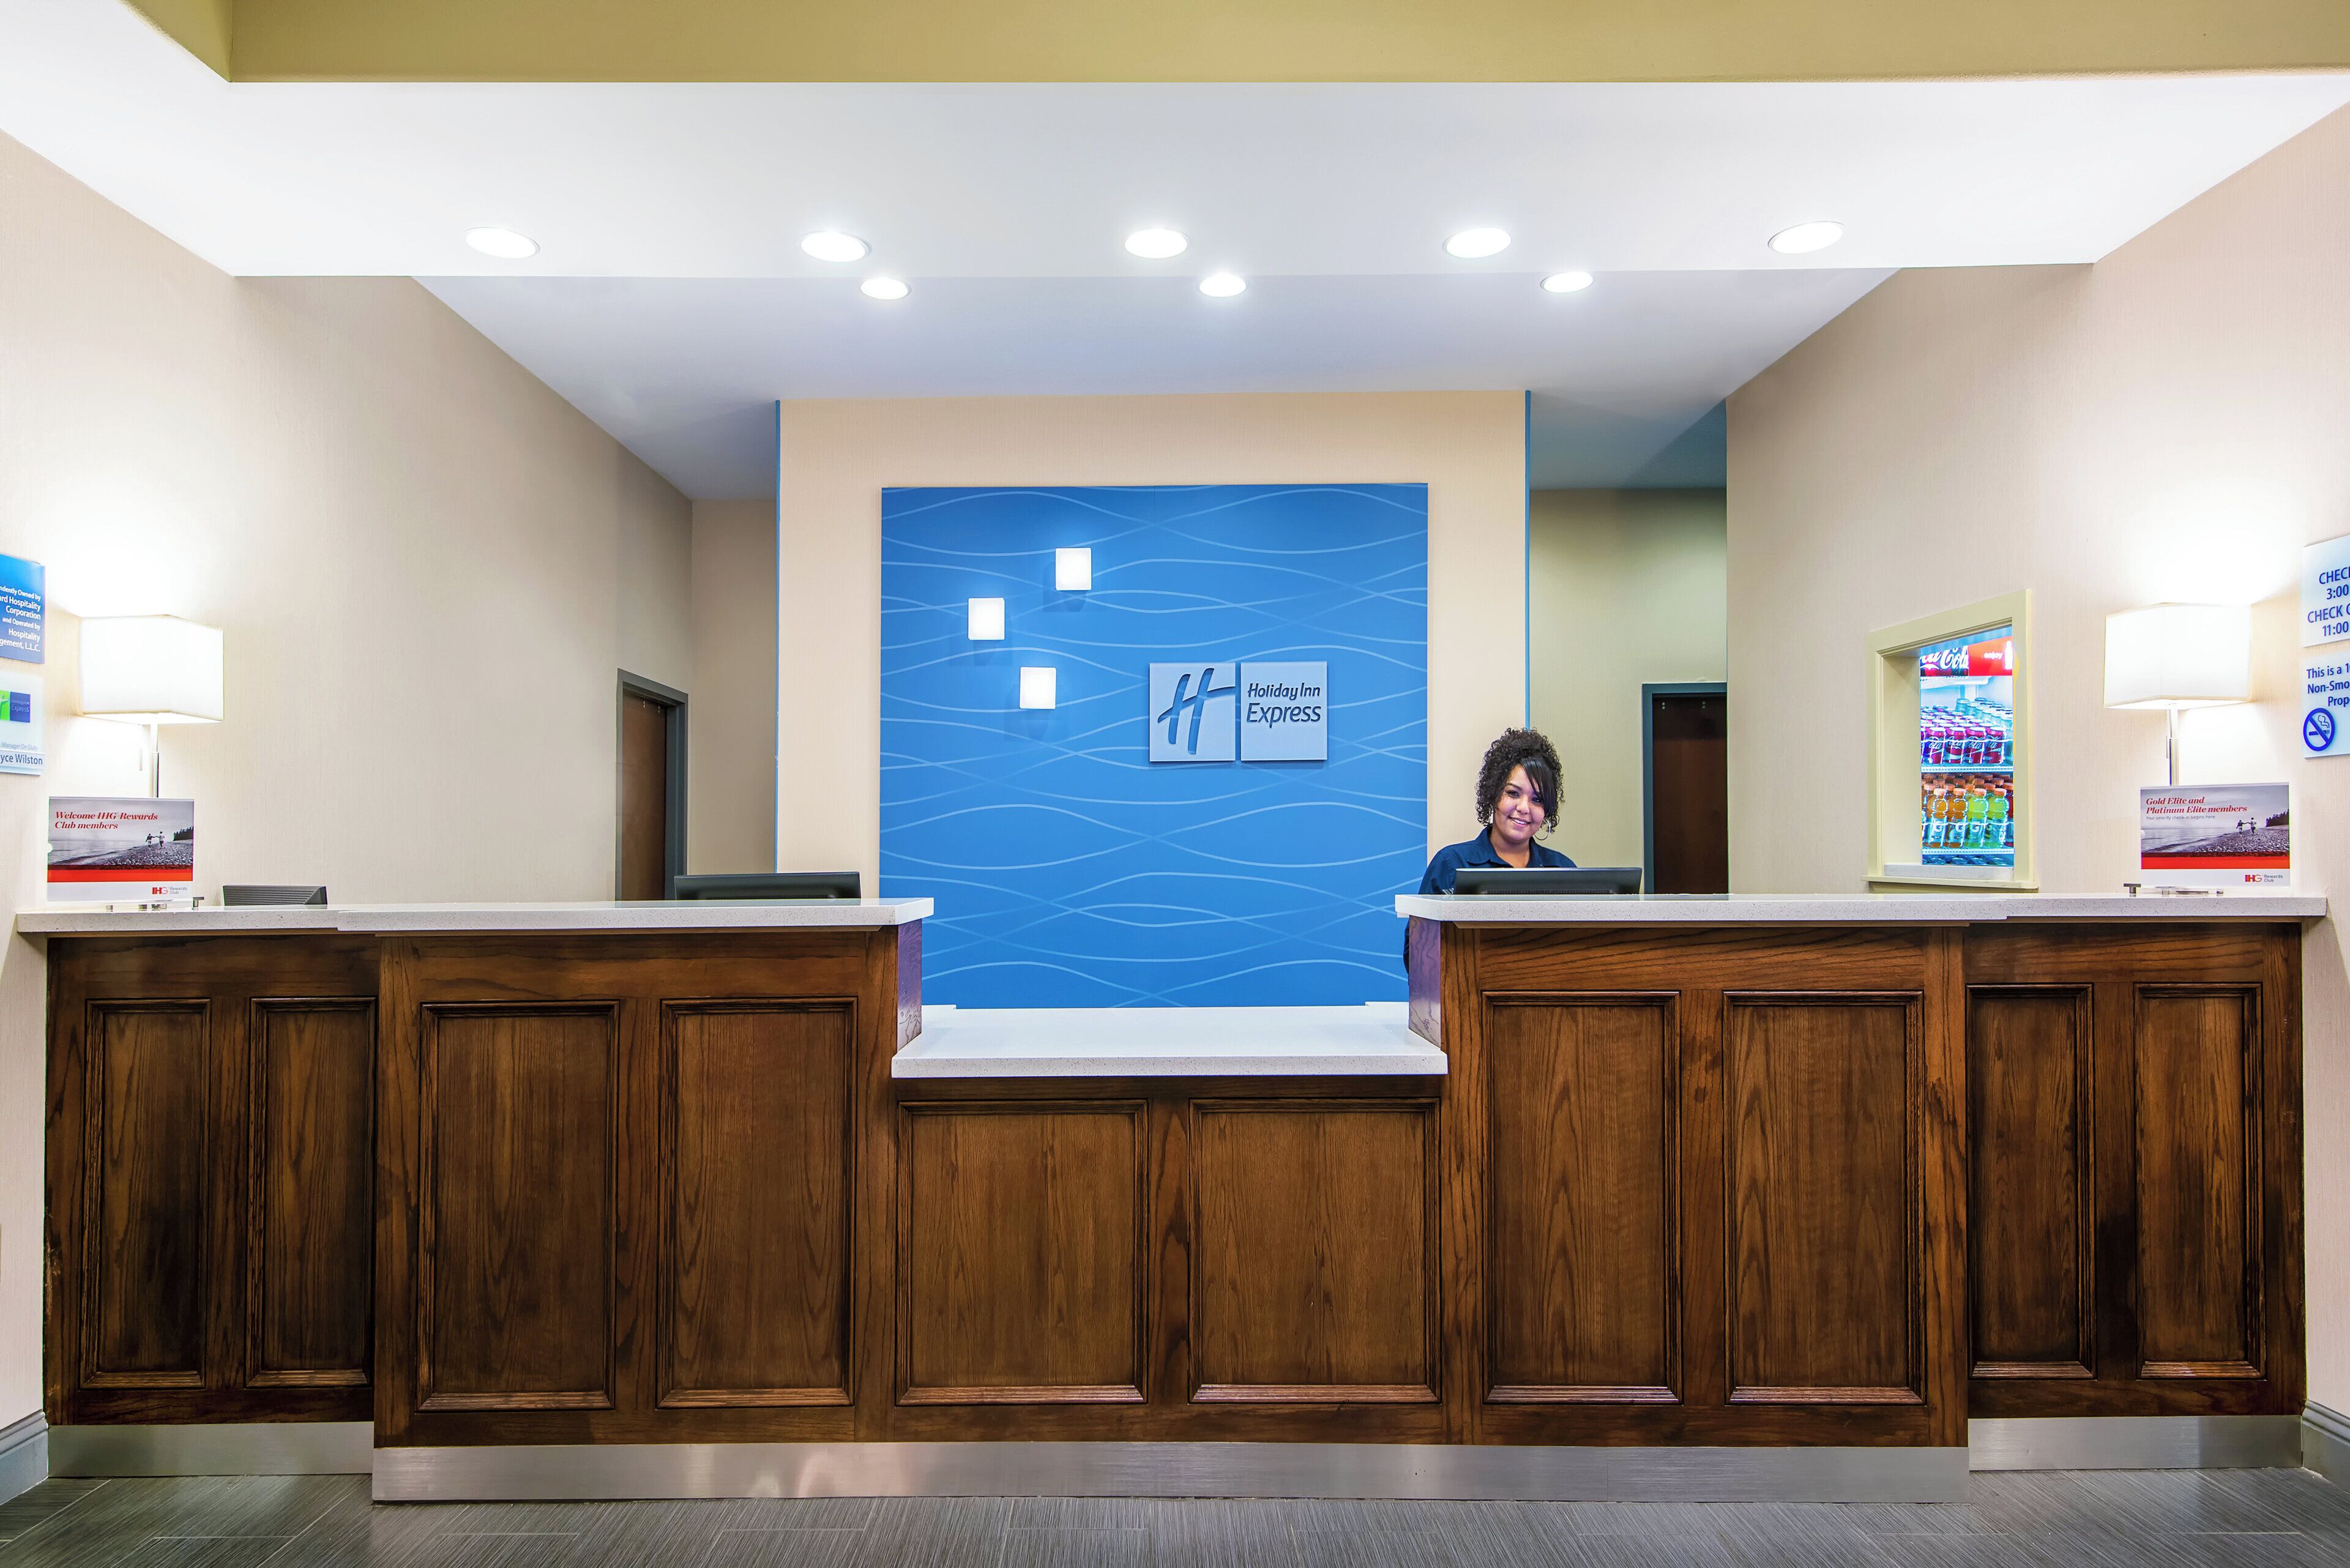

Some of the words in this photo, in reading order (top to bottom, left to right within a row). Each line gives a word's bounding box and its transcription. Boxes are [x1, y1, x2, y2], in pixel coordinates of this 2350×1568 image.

[2319, 566, 2350, 584] CHEC
[18, 589, 34, 599] Owned
[35, 593, 41, 602] by
[2326, 584, 2349, 600] 3:00
[9, 596, 41, 612] Hospitality
[6, 605, 41, 620] Corporation
[2308, 605, 2343, 623] CHECK
[12, 618, 34, 629] Operated
[34, 622, 40, 631] by
[2322, 621, 2349, 637] 11:00
[9, 628, 40, 643] Hospitality
[1983, 651, 2003, 660] enjoy
[2307, 666, 2324, 679] This
[2327, 665, 2334, 676] is
[1247, 682, 1298, 700] Holiday
[1299, 682, 1321, 697] Inn
[2307, 681, 2350, 694] Non-Smo
[12, 704, 29, 712] Express
[2327, 696, 2350, 707] Prop
[1246, 703, 1321, 729] Express
[1, 742, 20, 750] Manager
[1, 754, 13, 764] yce
[15, 753, 43, 765] Wilston
[56, 812, 95, 820] Welcome
